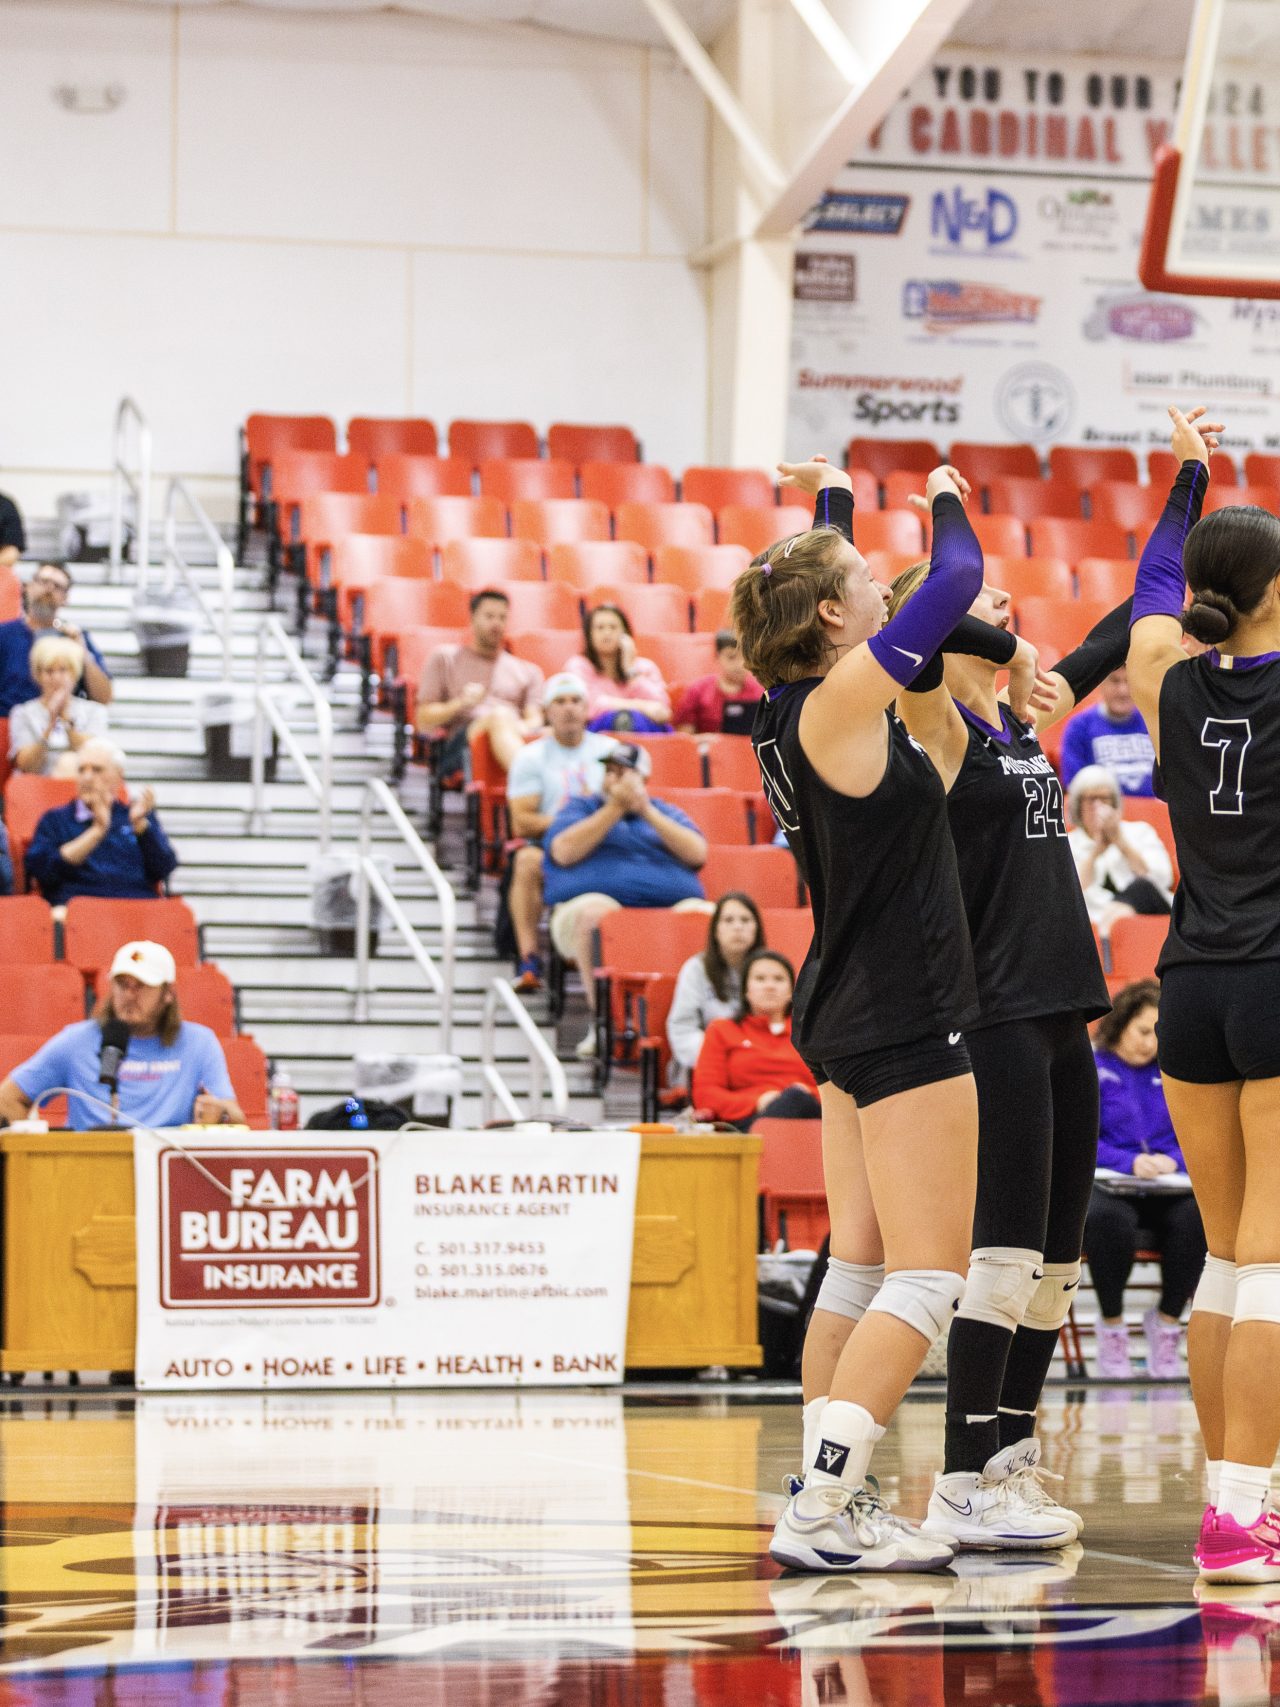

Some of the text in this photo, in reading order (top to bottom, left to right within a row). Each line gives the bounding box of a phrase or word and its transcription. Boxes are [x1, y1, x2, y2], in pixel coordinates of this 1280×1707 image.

[909, 105, 1120, 163] CARDINAL
[854, 393, 960, 427] Sports
[1201, 717, 1251, 815] 7
[1022, 777, 1067, 838] 24
[231, 1168, 357, 1207] FARM
[415, 1174, 619, 1194] BLAKE MARTIN
[414, 1203, 571, 1217] INSURANCE AGENT
[180, 1210, 359, 1251] BUREAU
[415, 1242, 430, 1255] C.
[203, 1263, 358, 1290] INSURANCE
[415, 1264, 432, 1276] O.
[164, 1353, 618, 1378] AUTO HOME LIFE HEALTH BANK
